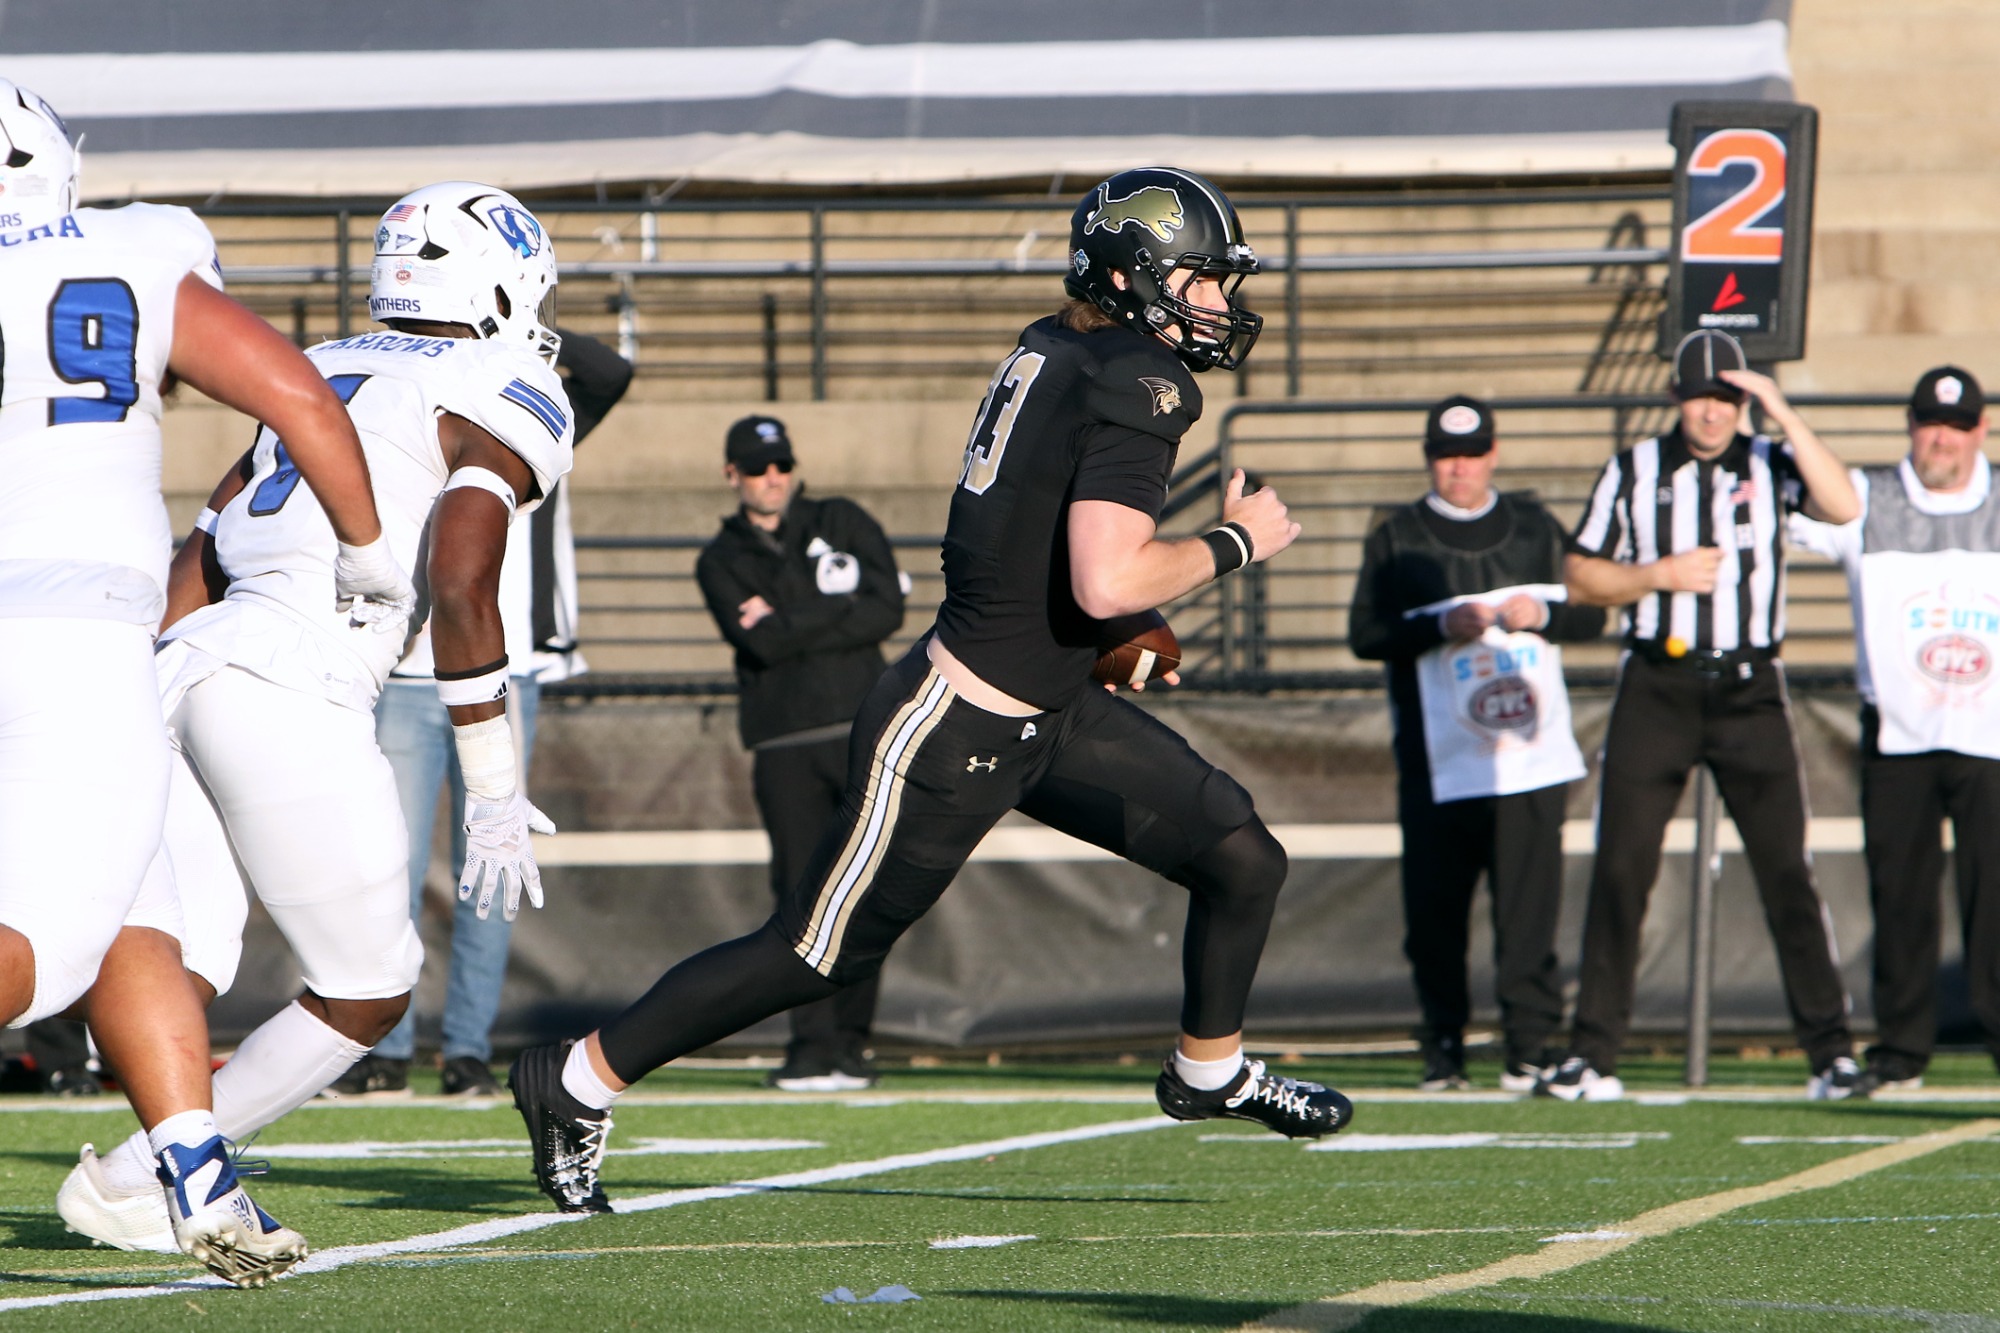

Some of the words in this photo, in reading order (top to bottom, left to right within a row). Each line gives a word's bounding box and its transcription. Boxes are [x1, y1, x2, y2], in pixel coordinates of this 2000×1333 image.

[1681, 128, 1787, 263] 2
[0, 213, 22, 228] RS
[370, 297, 421, 313] ANTHERS
[0, 277, 140, 427] 9
[313, 335, 455, 358] ARROWS
